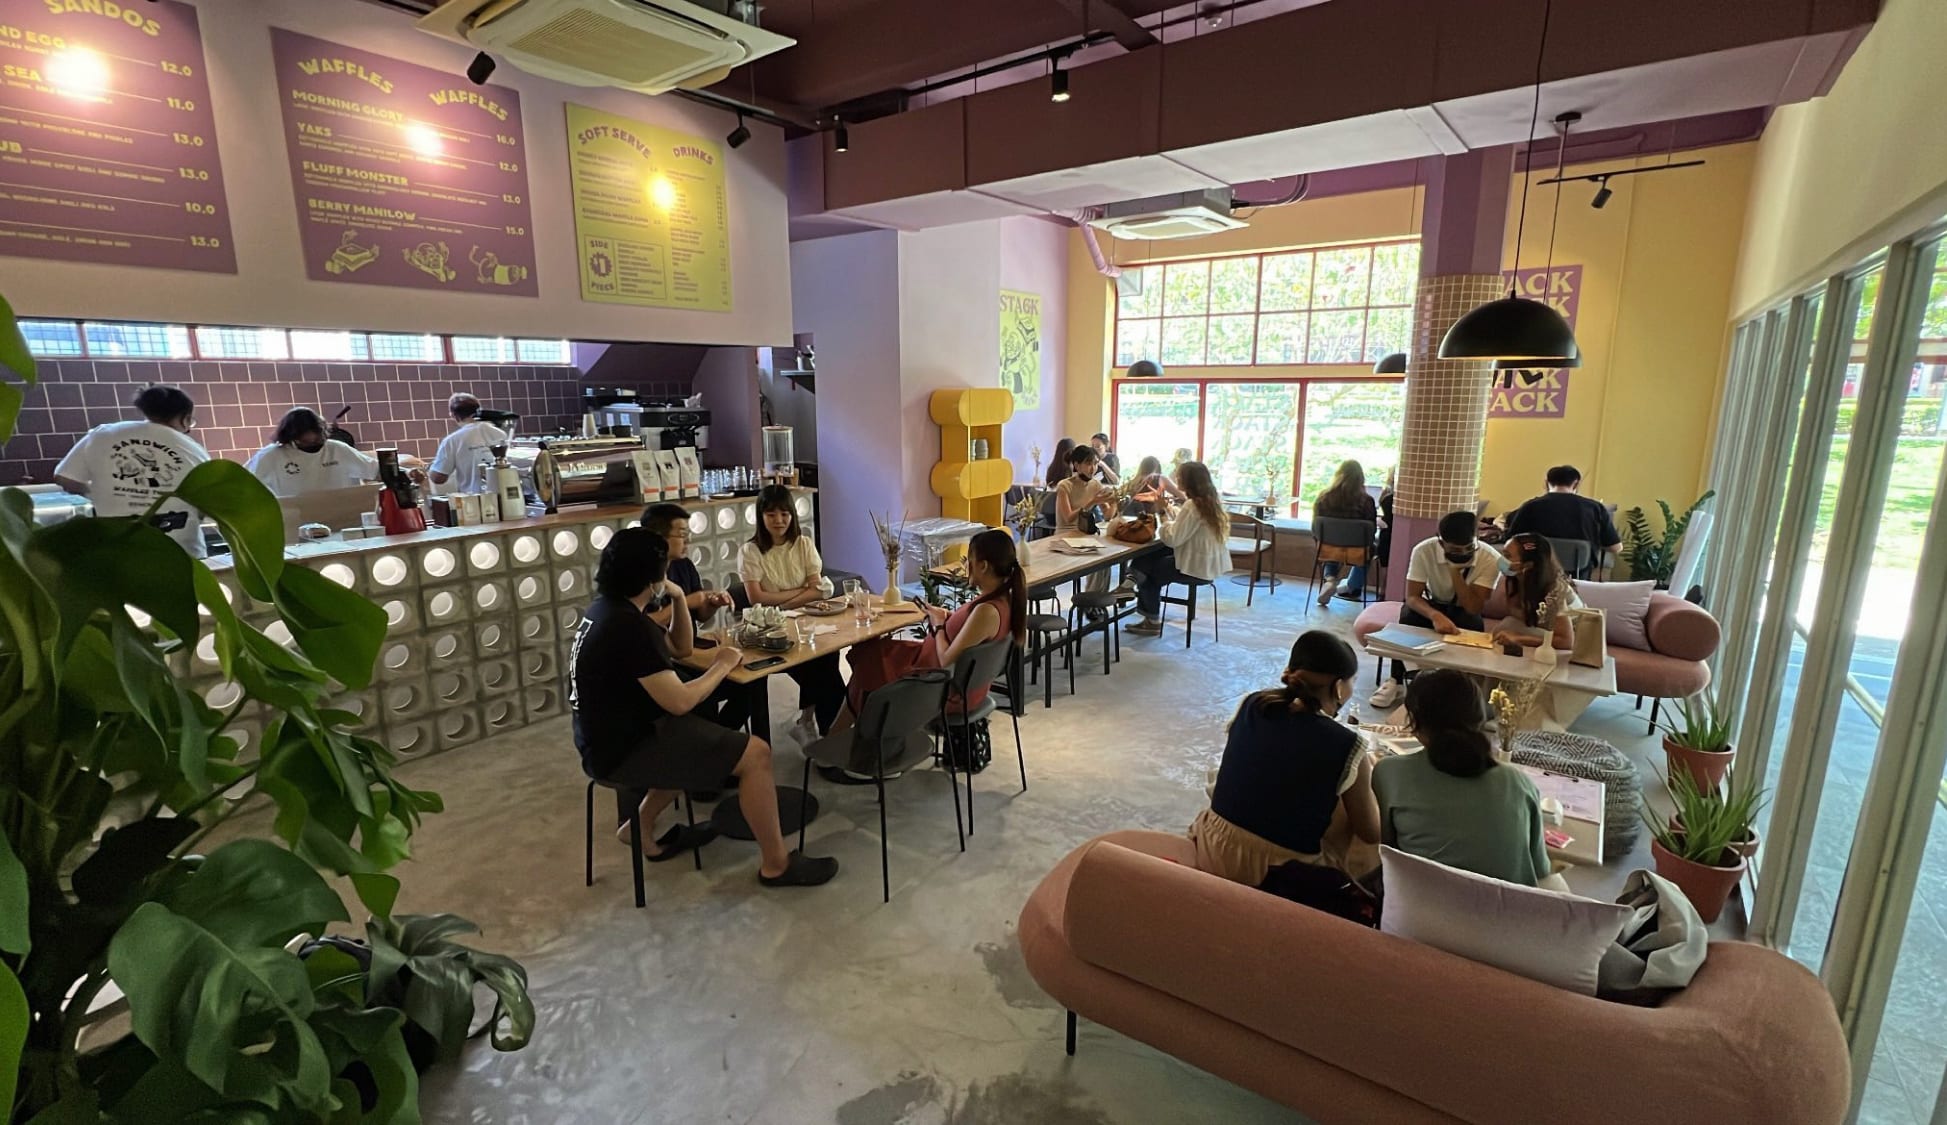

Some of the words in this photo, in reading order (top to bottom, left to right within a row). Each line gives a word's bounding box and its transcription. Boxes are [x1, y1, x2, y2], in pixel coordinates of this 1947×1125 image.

[46, 0, 160, 36] SANDOS
[0, 25, 21, 39] ND
[26, 30, 65, 48] EGG
[4, 64, 41, 82] SEA
[161, 61, 192, 77] 12.0
[297, 58, 394, 94] WAFFLES
[167, 96, 195, 112] 11.0
[292, 89, 360, 113] MORNING
[361, 104, 404, 122] GLORY
[428, 89, 508, 121] WAFFLES
[173, 131, 204, 147] 13.0
[297, 121, 332, 137] YAKS
[0, 140, 22, 153] UB
[577, 125, 609, 146] SOFT
[612, 127, 651, 159] SERVE
[672, 145, 714, 165] DRINKS
[302, 160, 344, 175] FLUFF
[346, 167, 409, 186] MONSTER
[186, 201, 216, 215] 10.0
[308, 198, 350, 213] BERRY
[353, 204, 416, 221] MANILOW
[1503, 271, 1574, 297] ACK
[1489, 391, 1560, 413] ACK
[112, 438, 183, 464] SANDWICH
